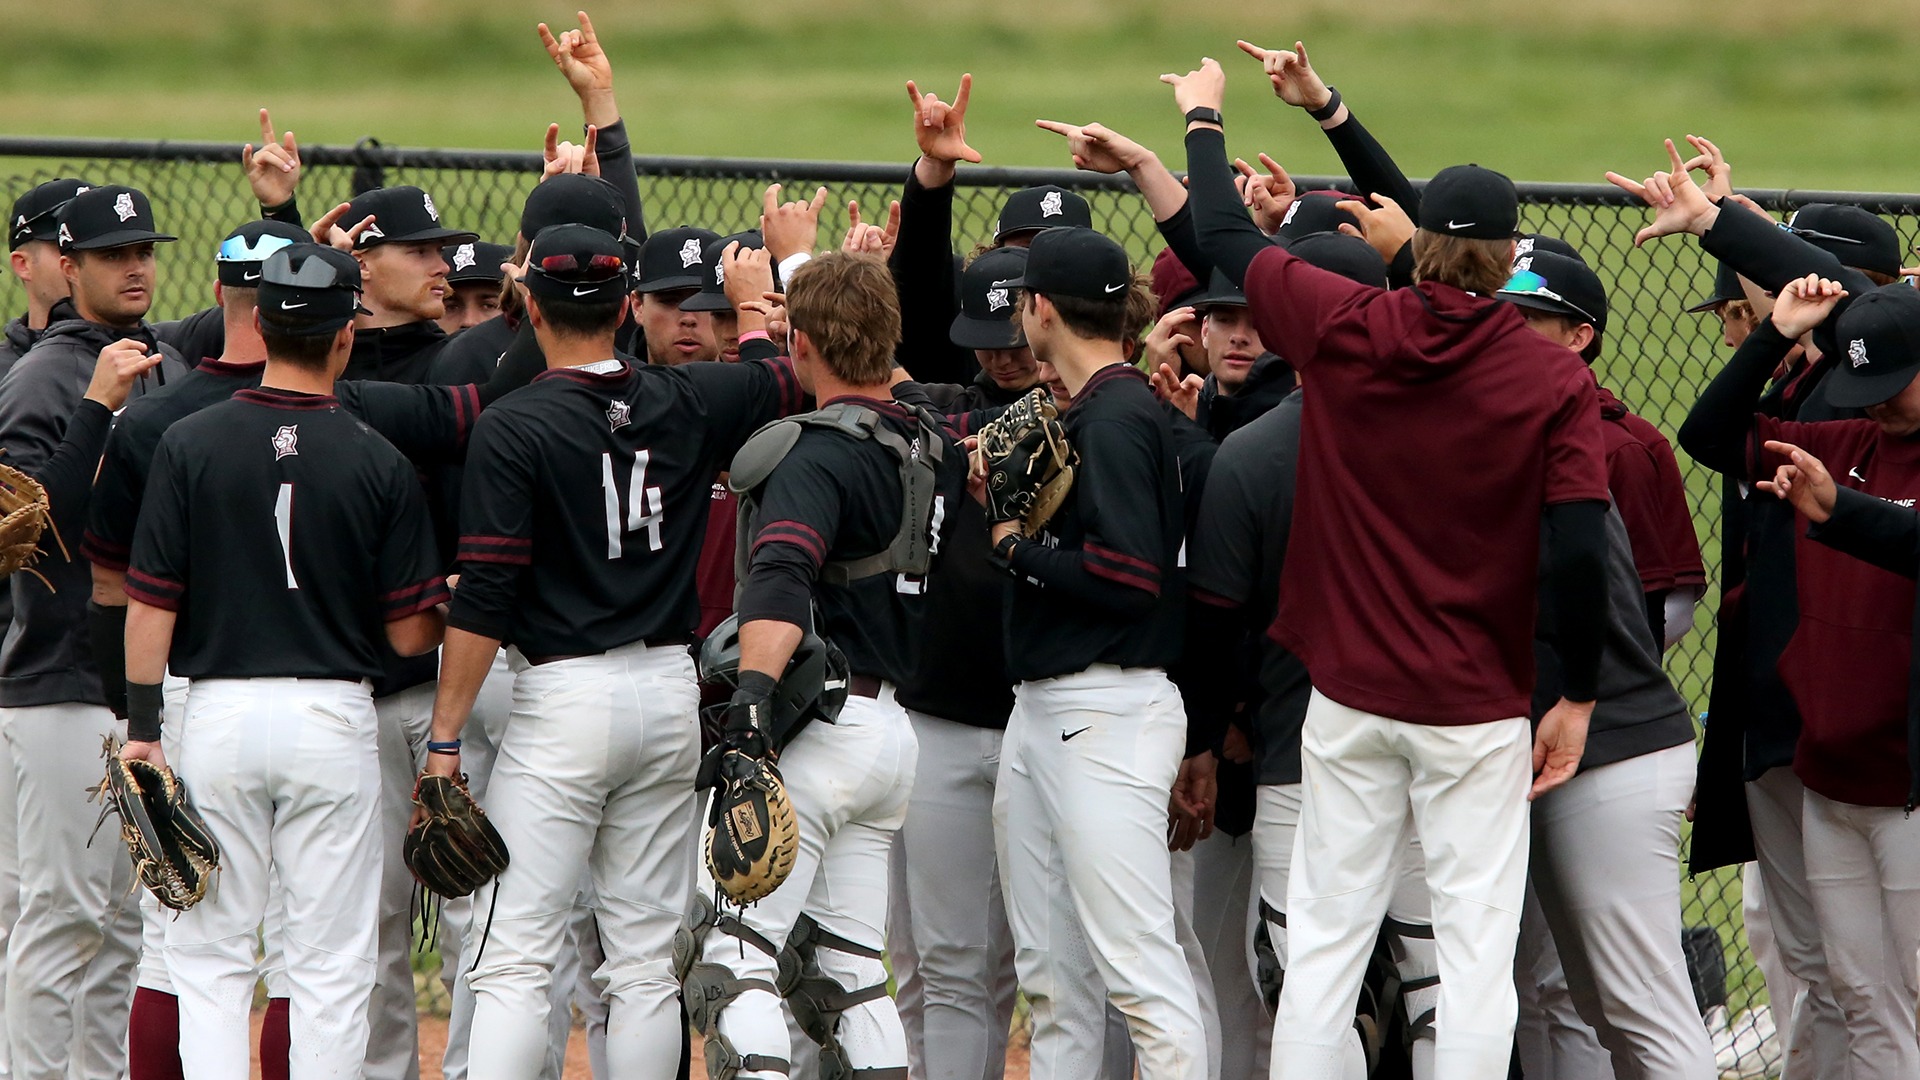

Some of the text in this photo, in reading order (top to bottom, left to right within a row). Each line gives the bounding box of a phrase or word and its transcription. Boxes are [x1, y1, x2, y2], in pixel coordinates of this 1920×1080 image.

[600, 362, 614, 371] PRO
[274, 483, 299, 589] 1
[602, 449, 664, 560] 14
